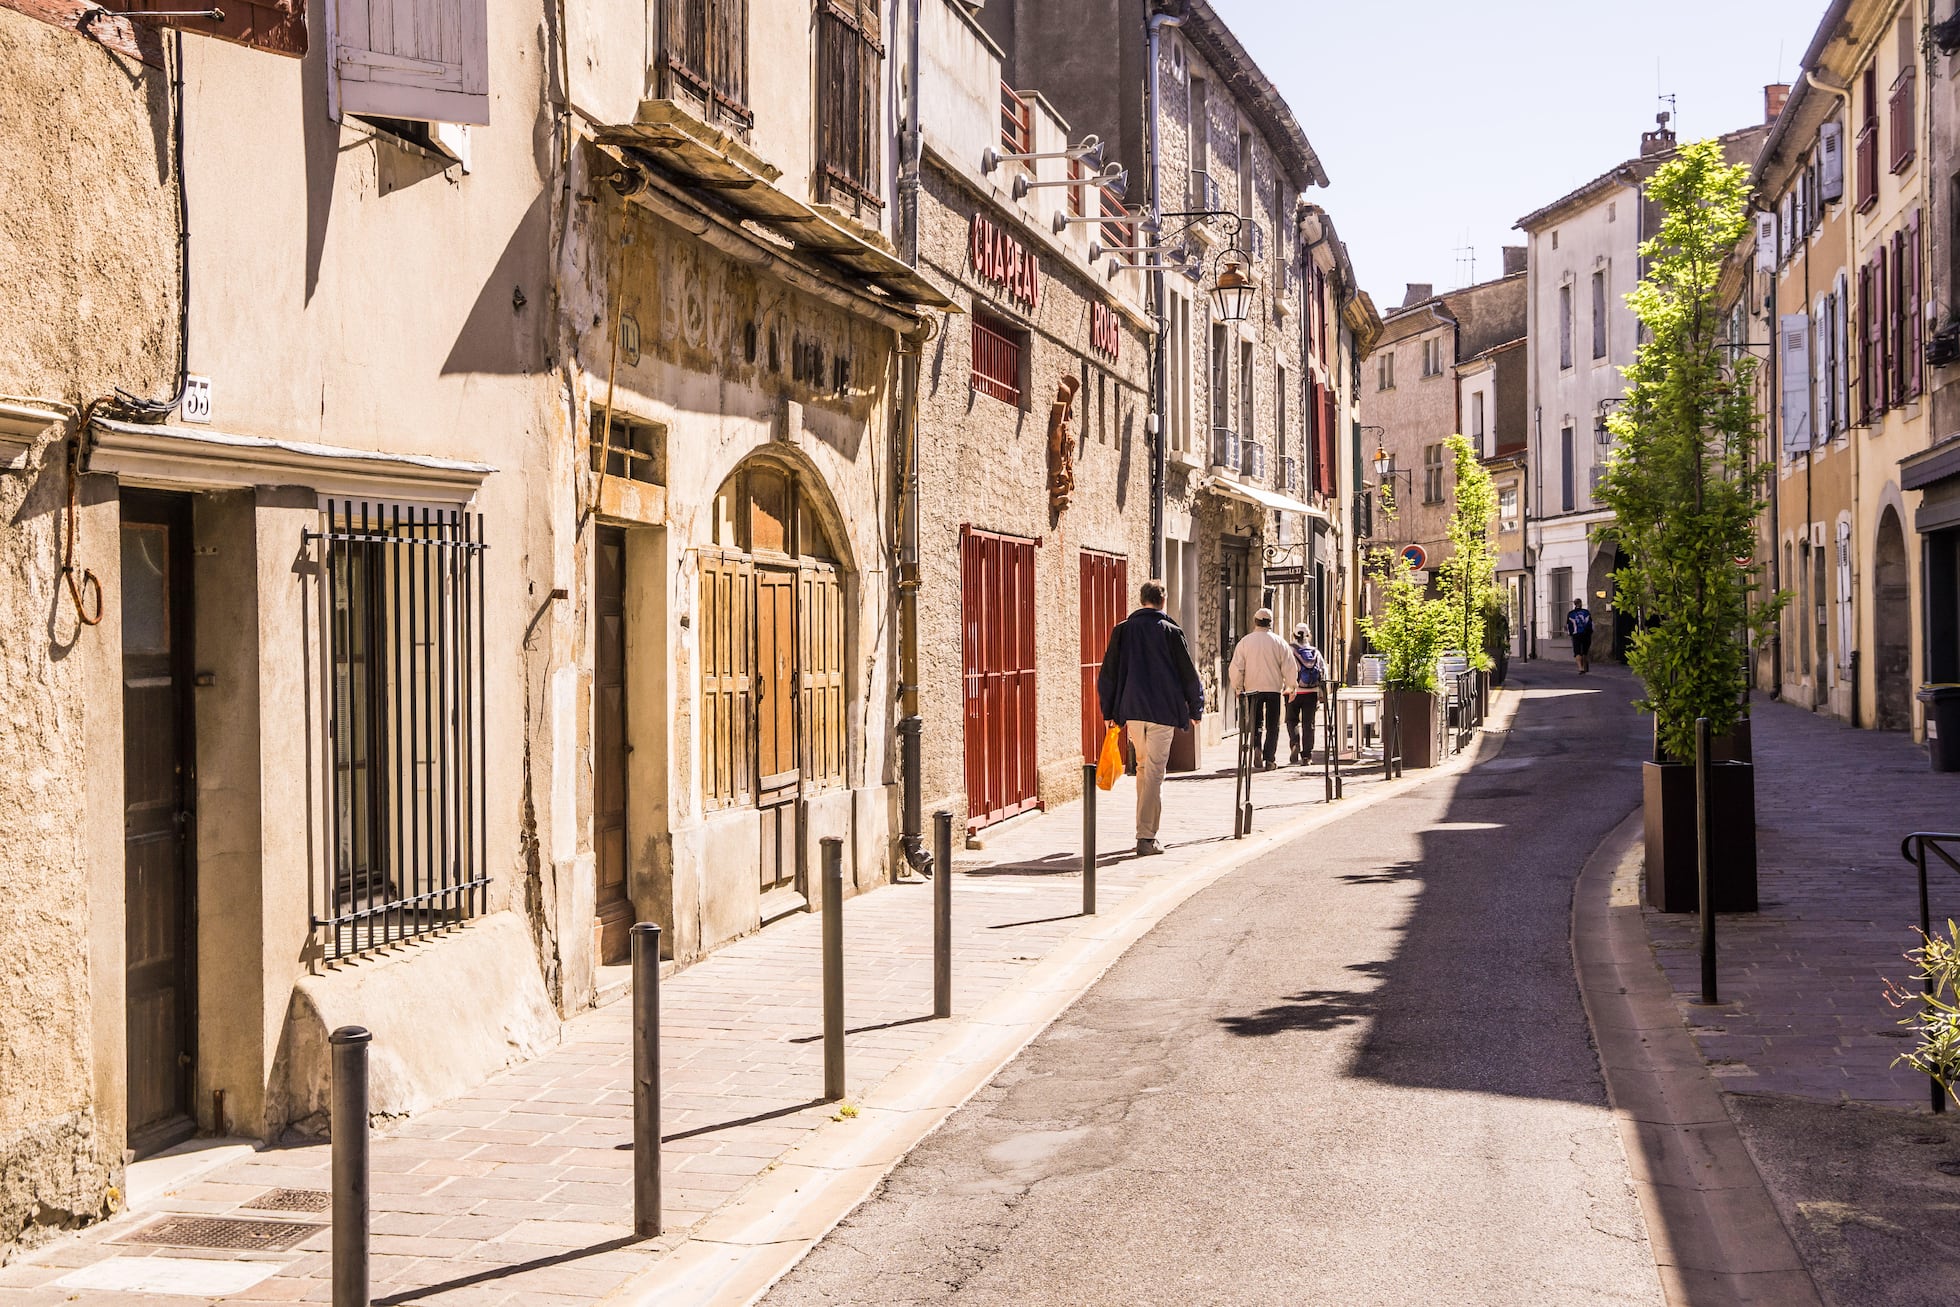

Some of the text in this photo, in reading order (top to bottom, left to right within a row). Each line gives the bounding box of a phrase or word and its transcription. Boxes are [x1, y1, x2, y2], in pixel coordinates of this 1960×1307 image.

[972, 212, 1120, 358] CHAPEAU ROUG
[188, 380, 209, 416] 33
